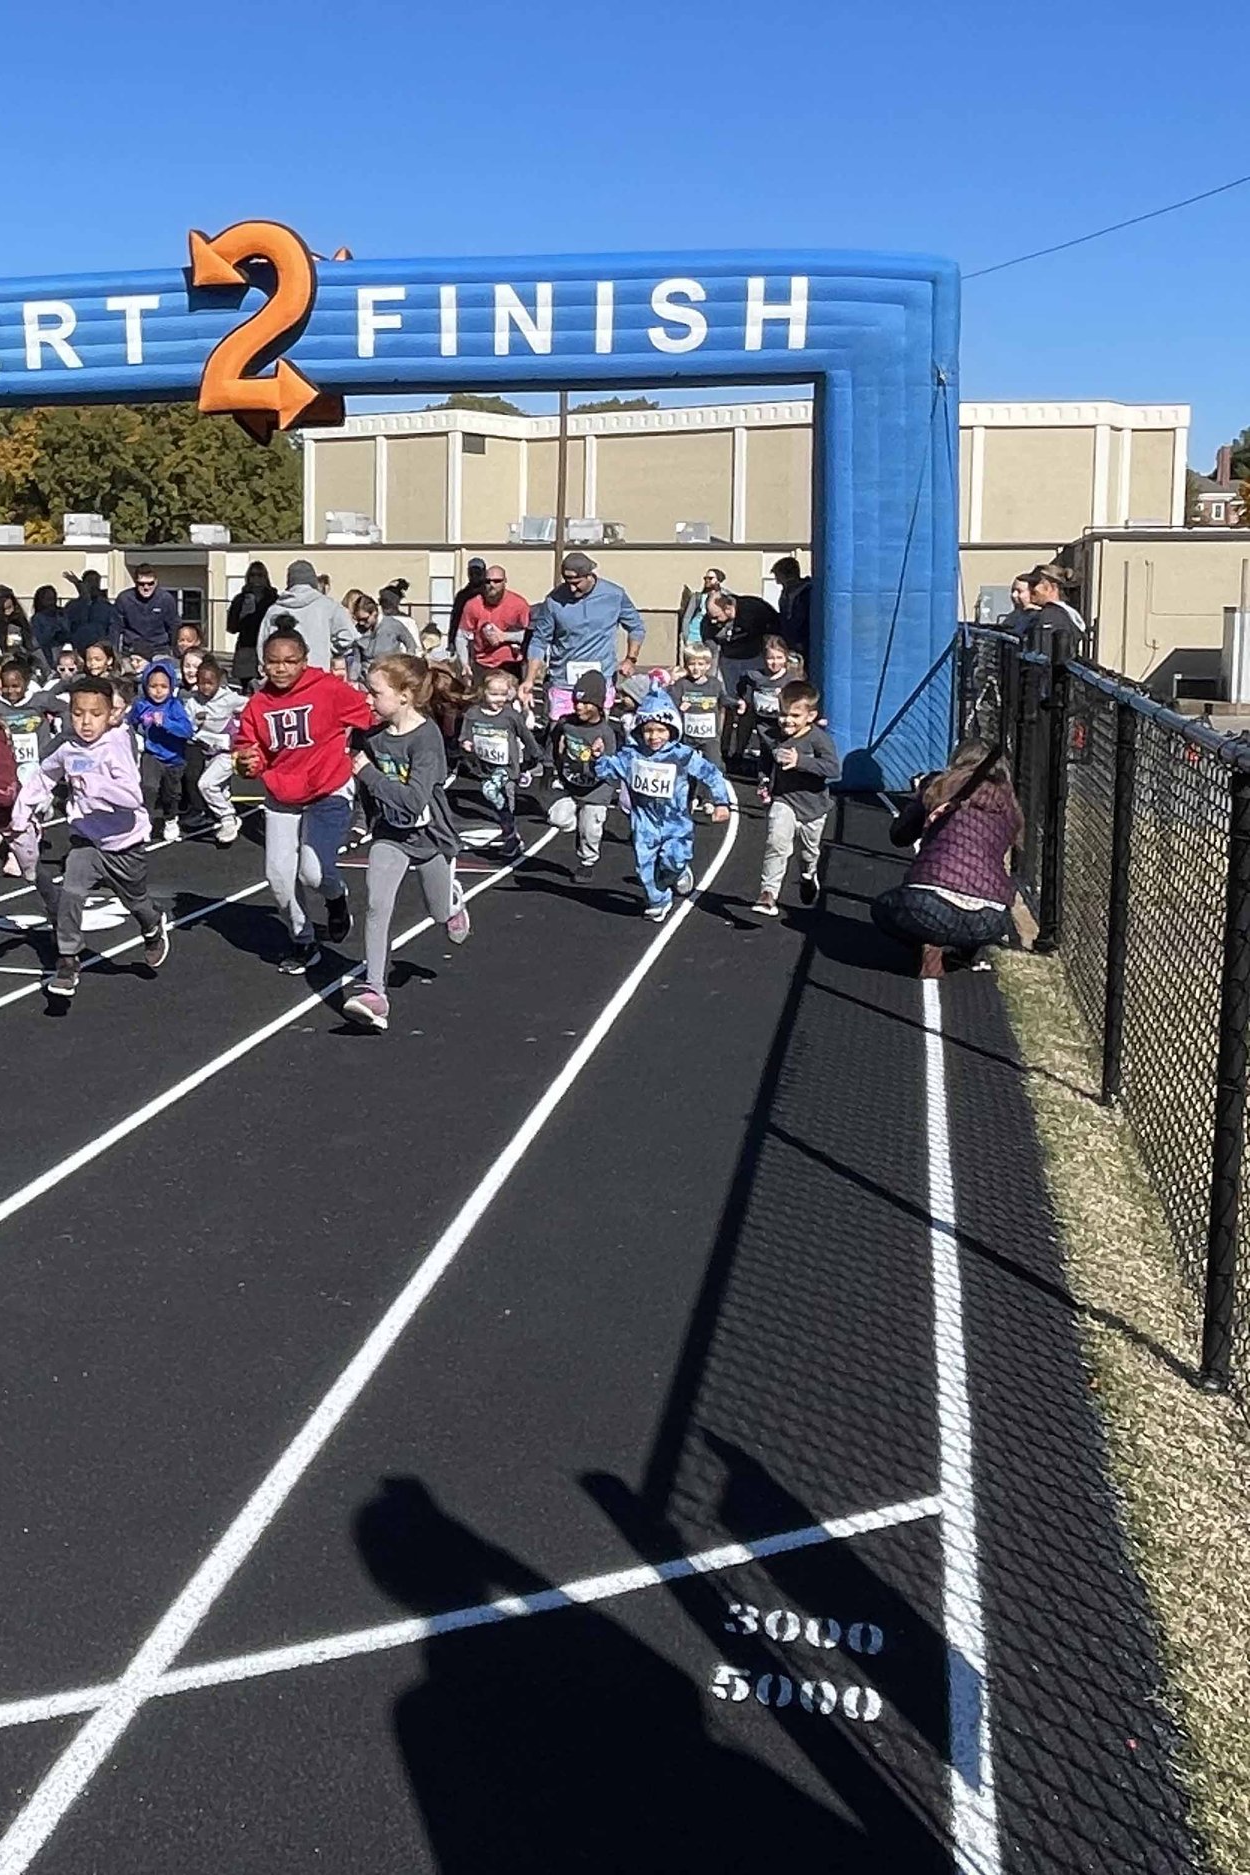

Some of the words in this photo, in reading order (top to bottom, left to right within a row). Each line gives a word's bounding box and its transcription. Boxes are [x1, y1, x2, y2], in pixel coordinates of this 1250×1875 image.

[357, 276, 808, 358] FINISH
[263, 704, 314, 752] H
[687, 724, 712, 735] DASH
[477, 746, 505, 762] DASH
[634, 774, 670, 793] DASH
[724, 1602, 884, 1655] 3000
[708, 1663, 883, 1722] 5000
